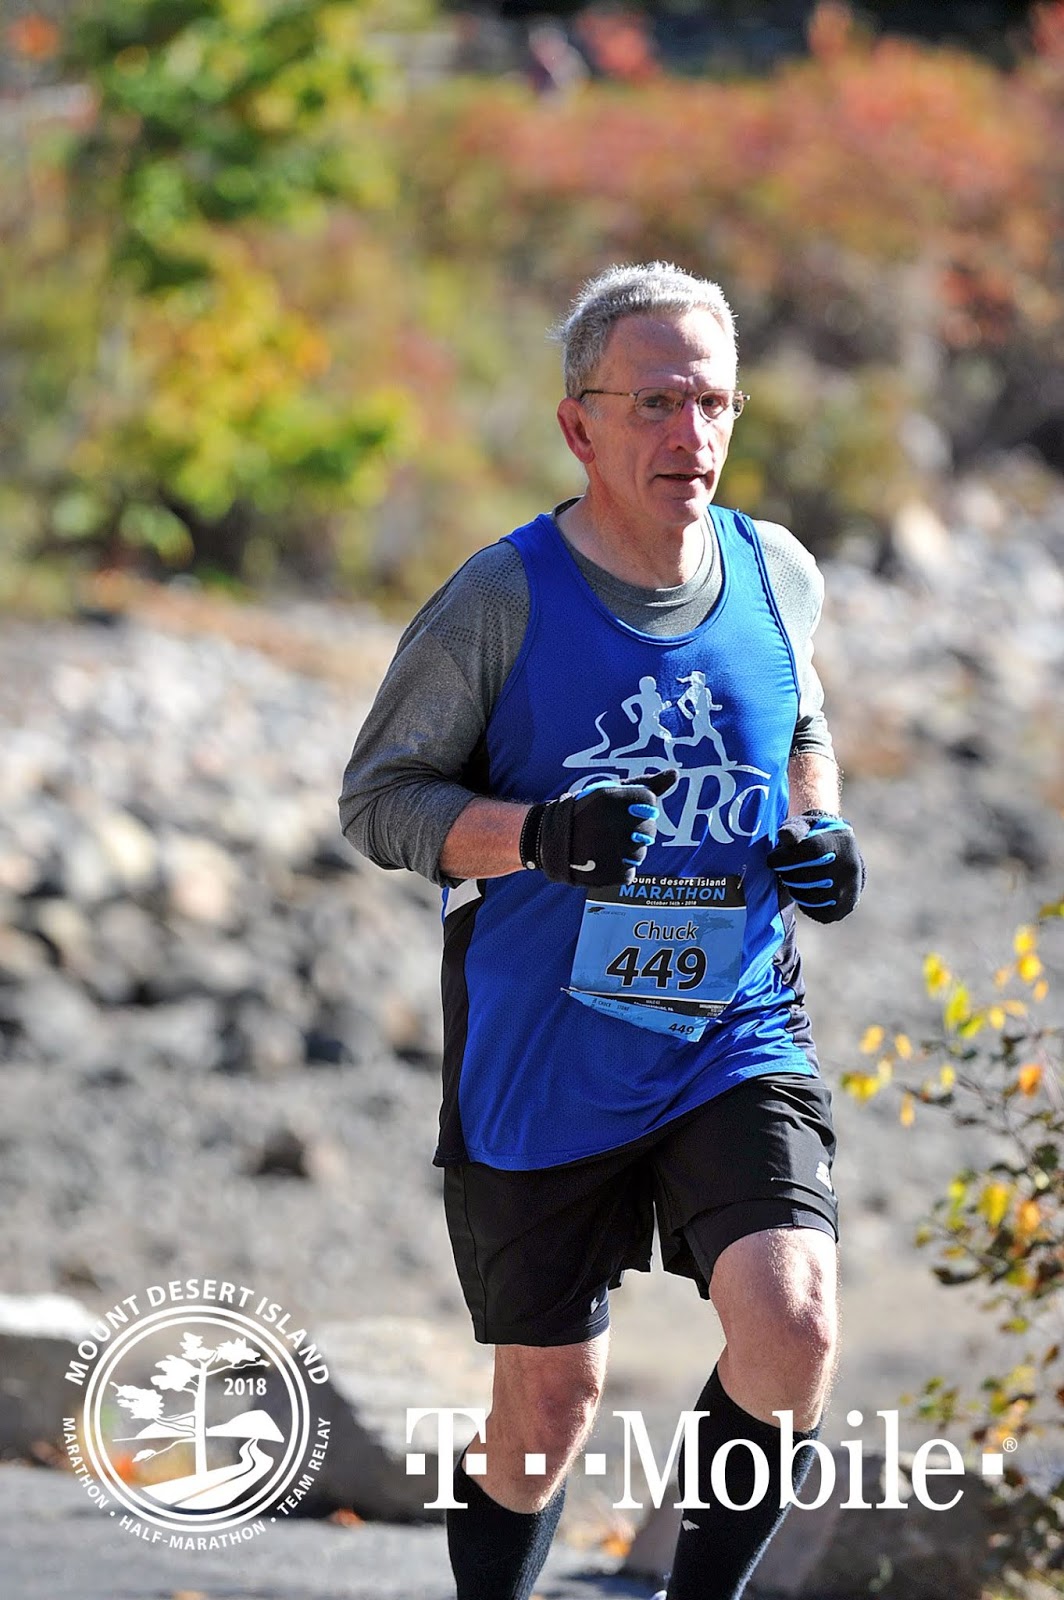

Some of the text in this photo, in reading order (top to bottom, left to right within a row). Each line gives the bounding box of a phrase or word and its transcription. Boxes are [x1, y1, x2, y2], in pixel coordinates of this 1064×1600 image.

[630, 877, 656, 885] ount
[660, 878, 695, 886] desert
[619, 885, 726, 900] MARATHON
[633, 920, 700, 940] Chuck
[605, 946, 708, 990] 449
[668, 1023, 695, 1035] 449
